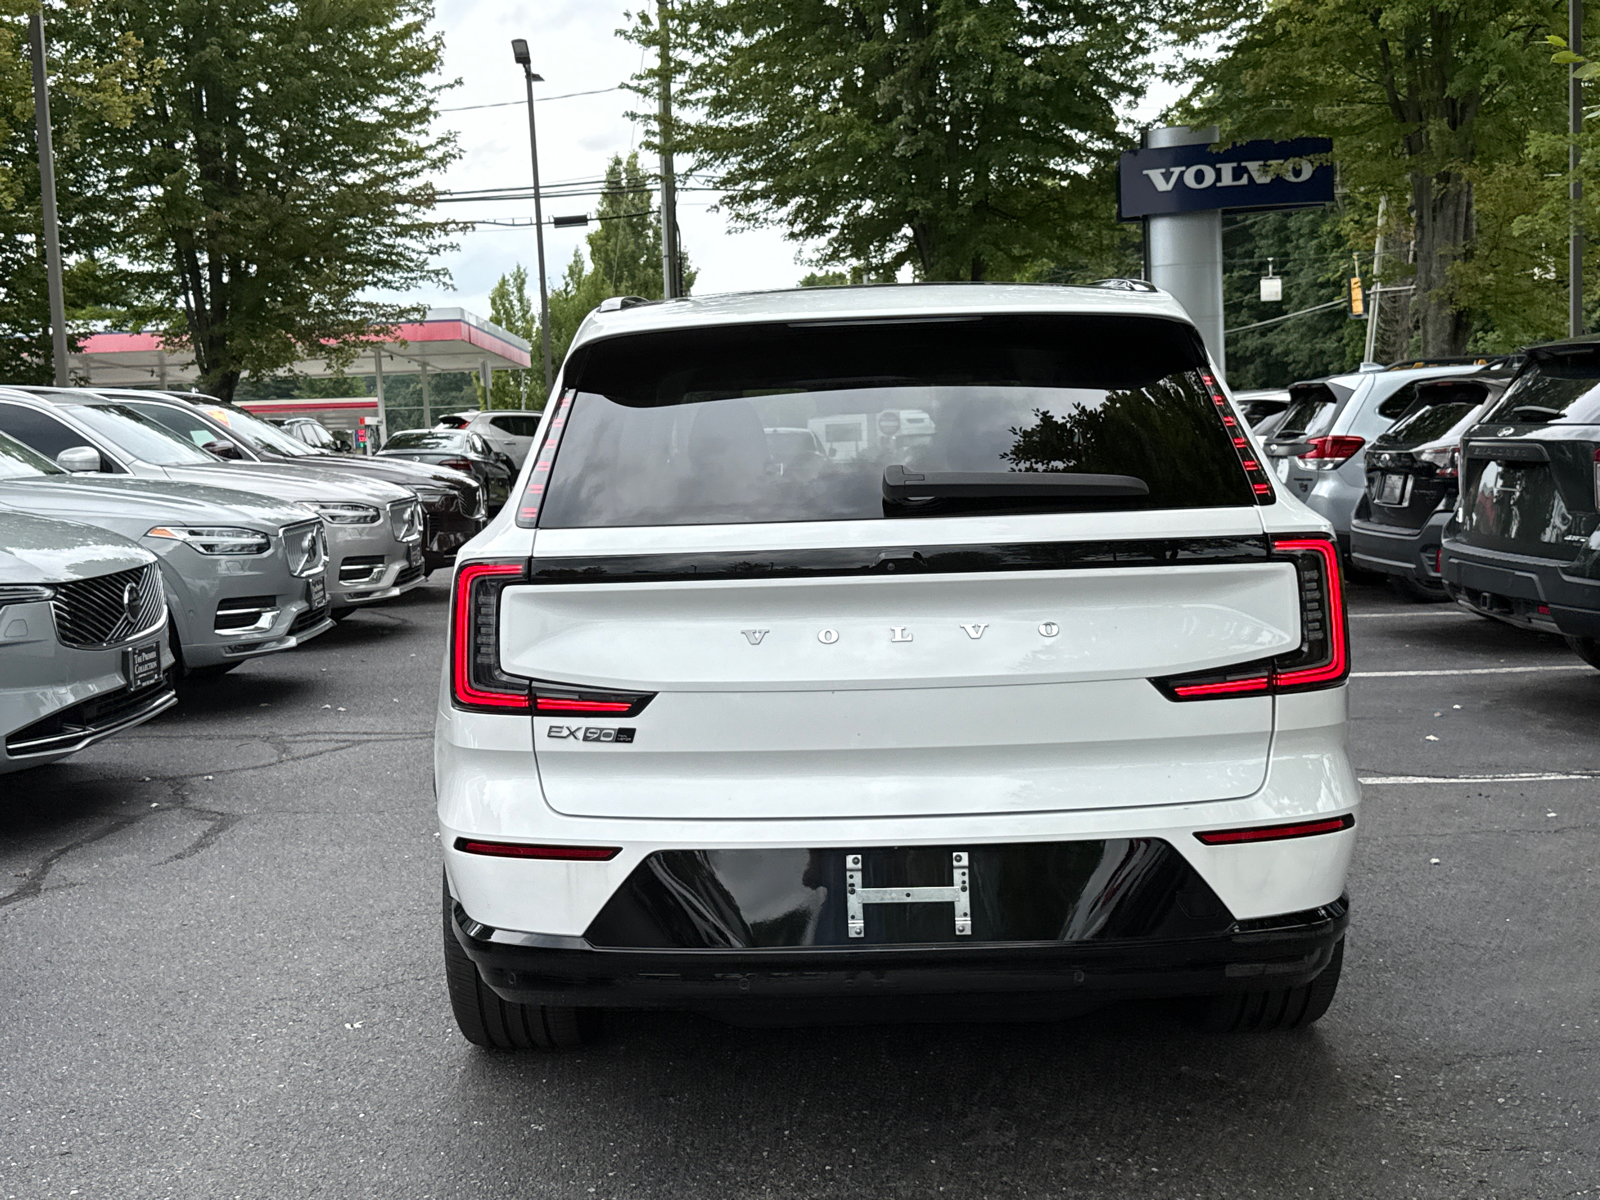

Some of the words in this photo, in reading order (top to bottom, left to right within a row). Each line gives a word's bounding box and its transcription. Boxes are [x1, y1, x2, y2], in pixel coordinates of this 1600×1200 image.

[1142, 158, 1313, 192] VOLVO
[741, 622, 1060, 645] VOLVO
[547, 725, 616, 742] EX90
